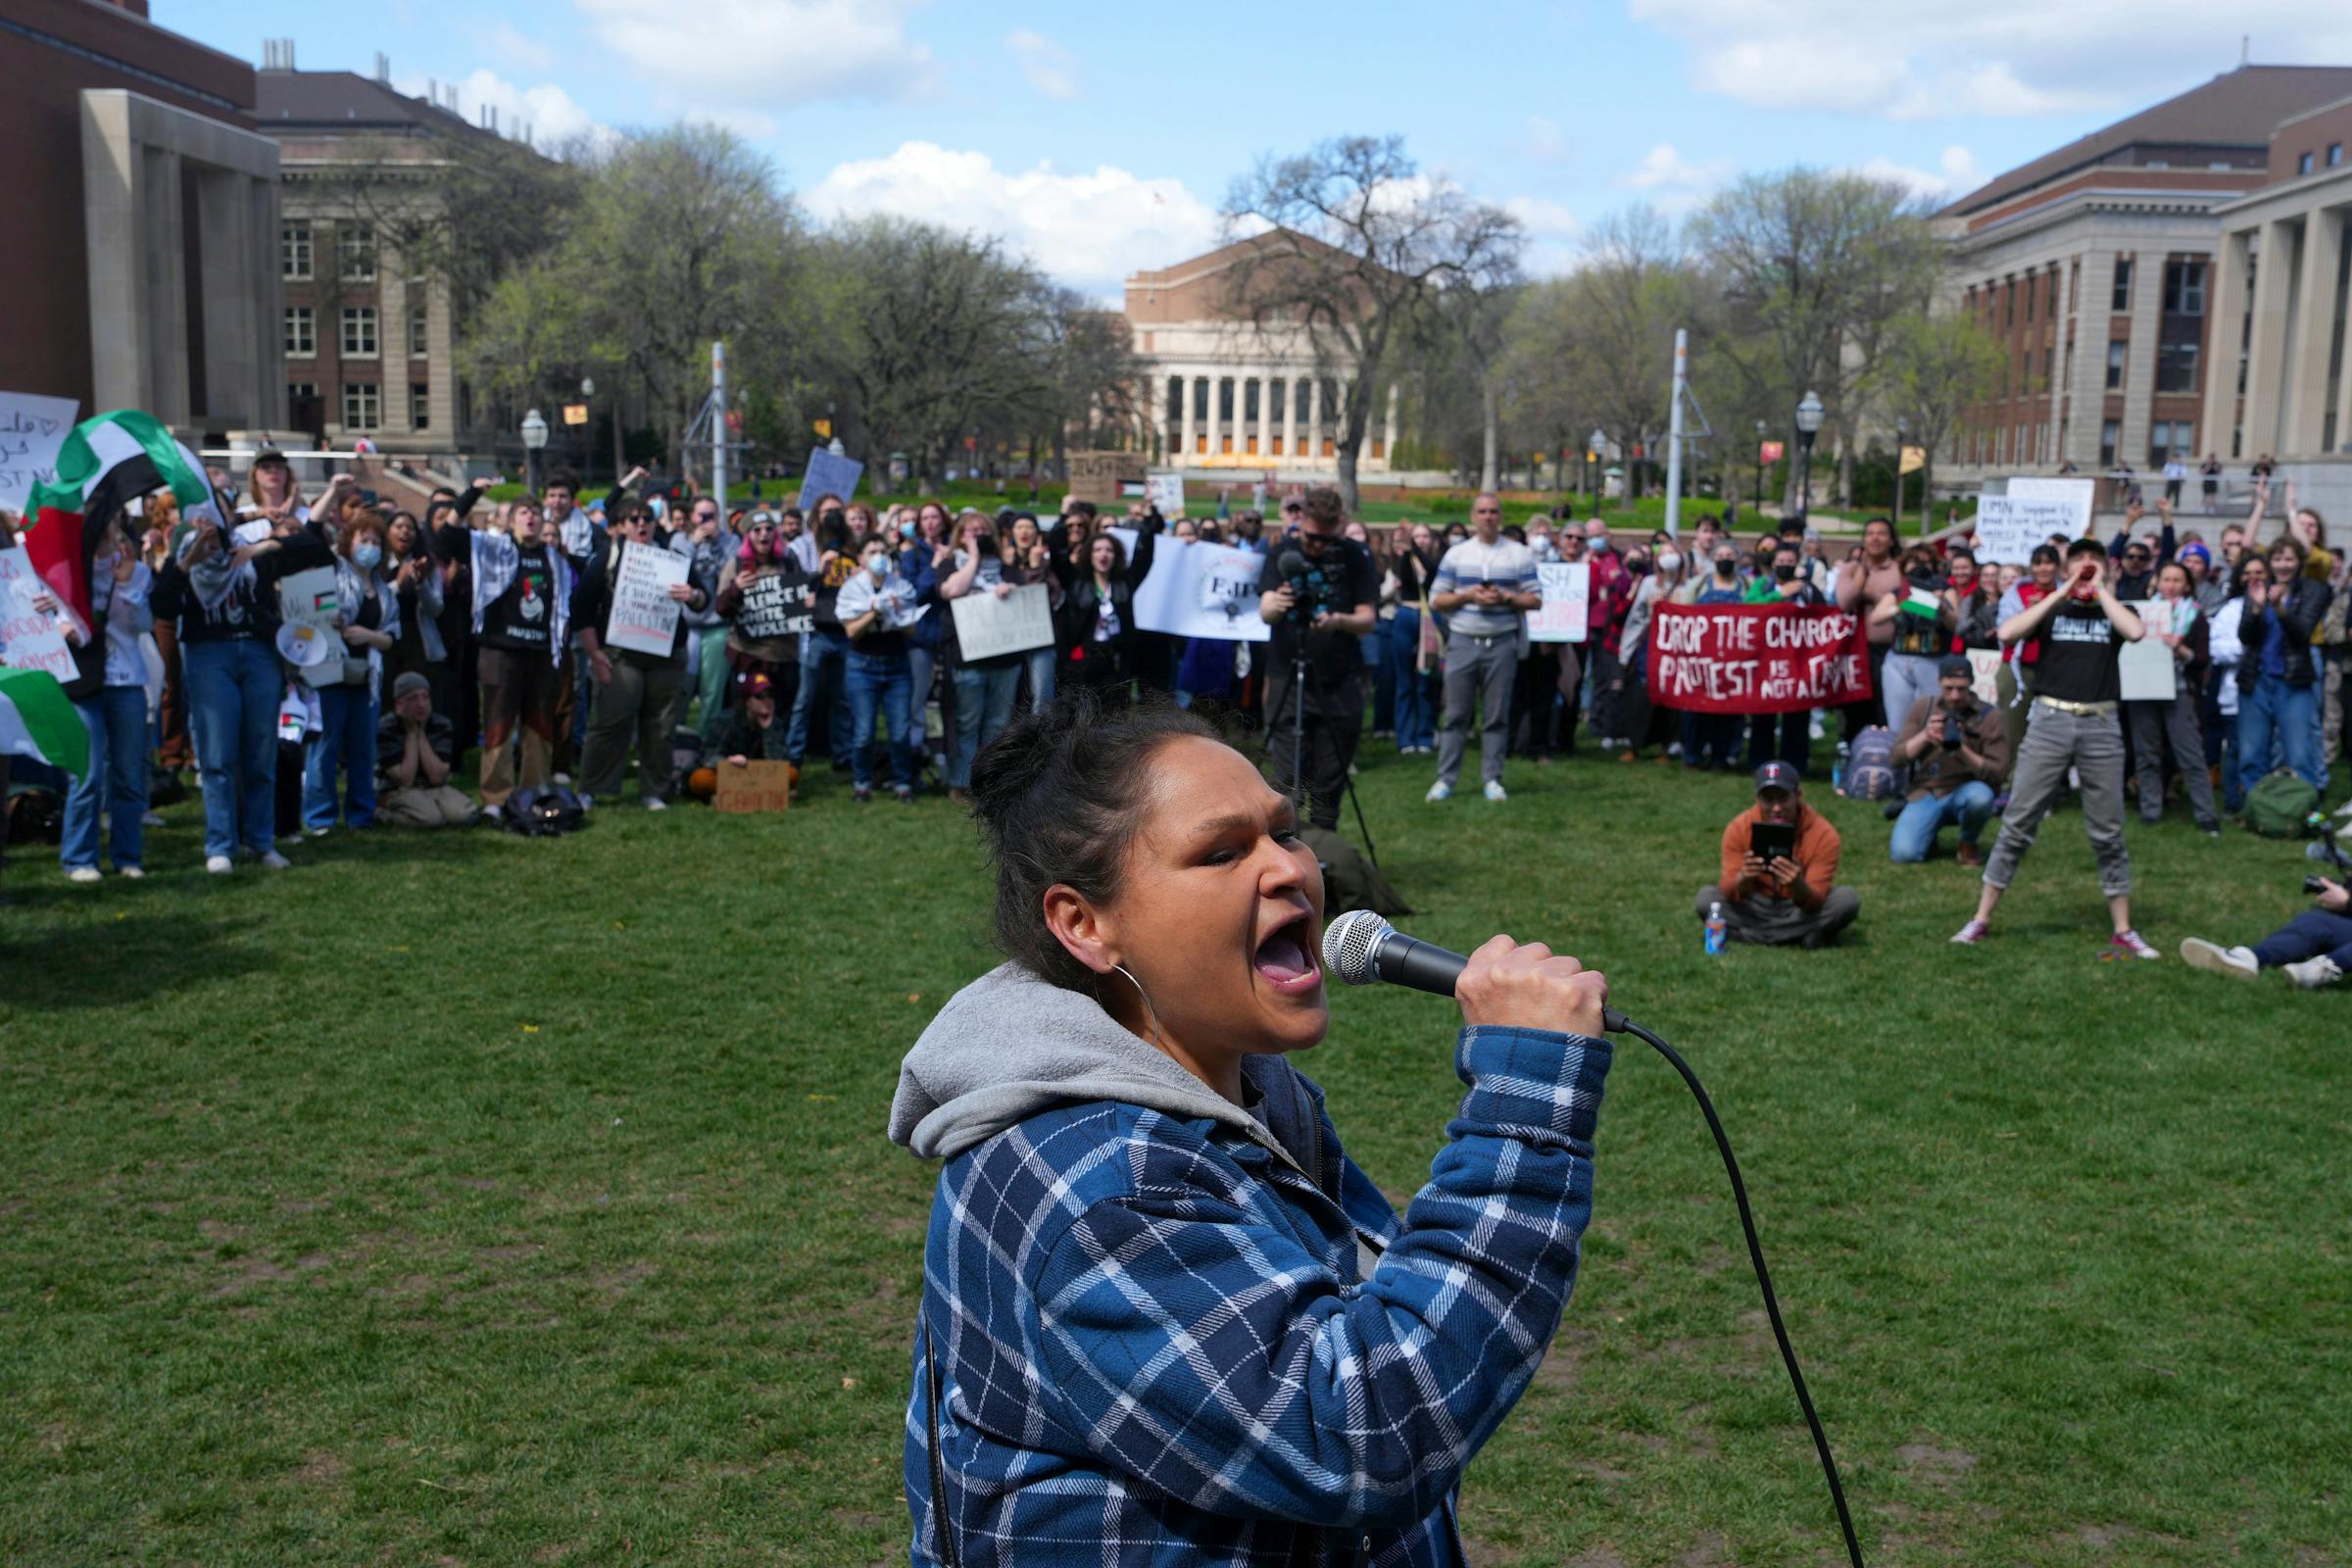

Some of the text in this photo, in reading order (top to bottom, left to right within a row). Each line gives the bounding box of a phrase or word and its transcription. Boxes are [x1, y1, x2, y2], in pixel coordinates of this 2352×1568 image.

[1656, 613, 1709, 654] DROP
[1712, 616, 1758, 651] THE
[1659, 654, 1759, 700] PROTEST
[1769, 660, 1790, 677] IS
[1760, 678, 1795, 700] NOT
[1796, 679, 1810, 700] A
